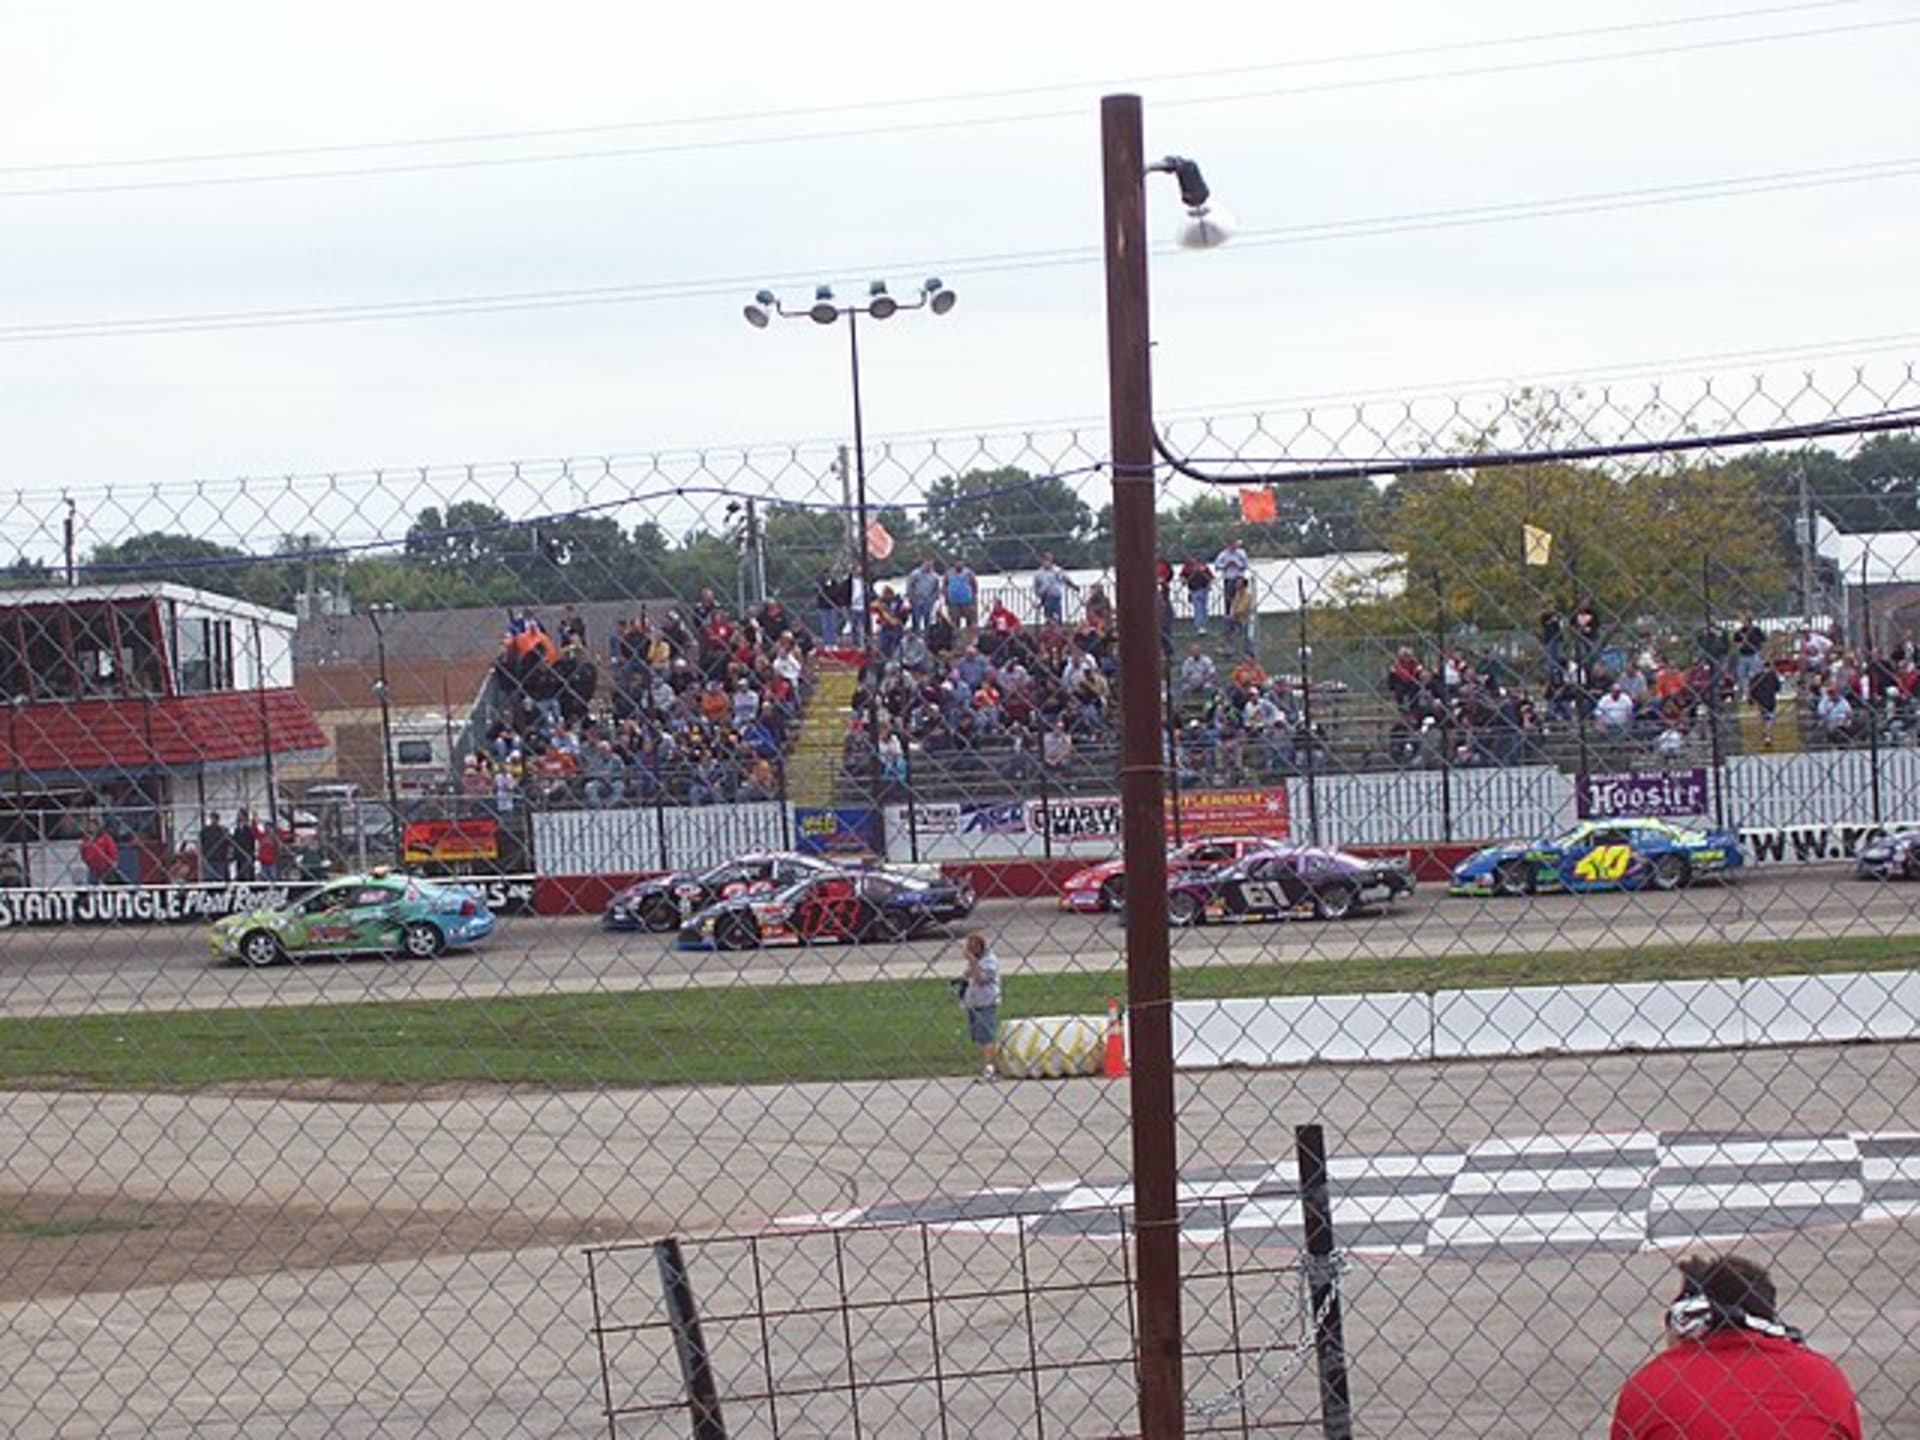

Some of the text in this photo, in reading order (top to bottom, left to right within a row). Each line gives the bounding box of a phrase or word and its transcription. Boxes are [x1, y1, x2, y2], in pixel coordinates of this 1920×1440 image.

[1588, 778, 1701, 815] Hoosier
[1573, 844, 1633, 881] 40
[77, 888, 180, 919] JUNGLE
